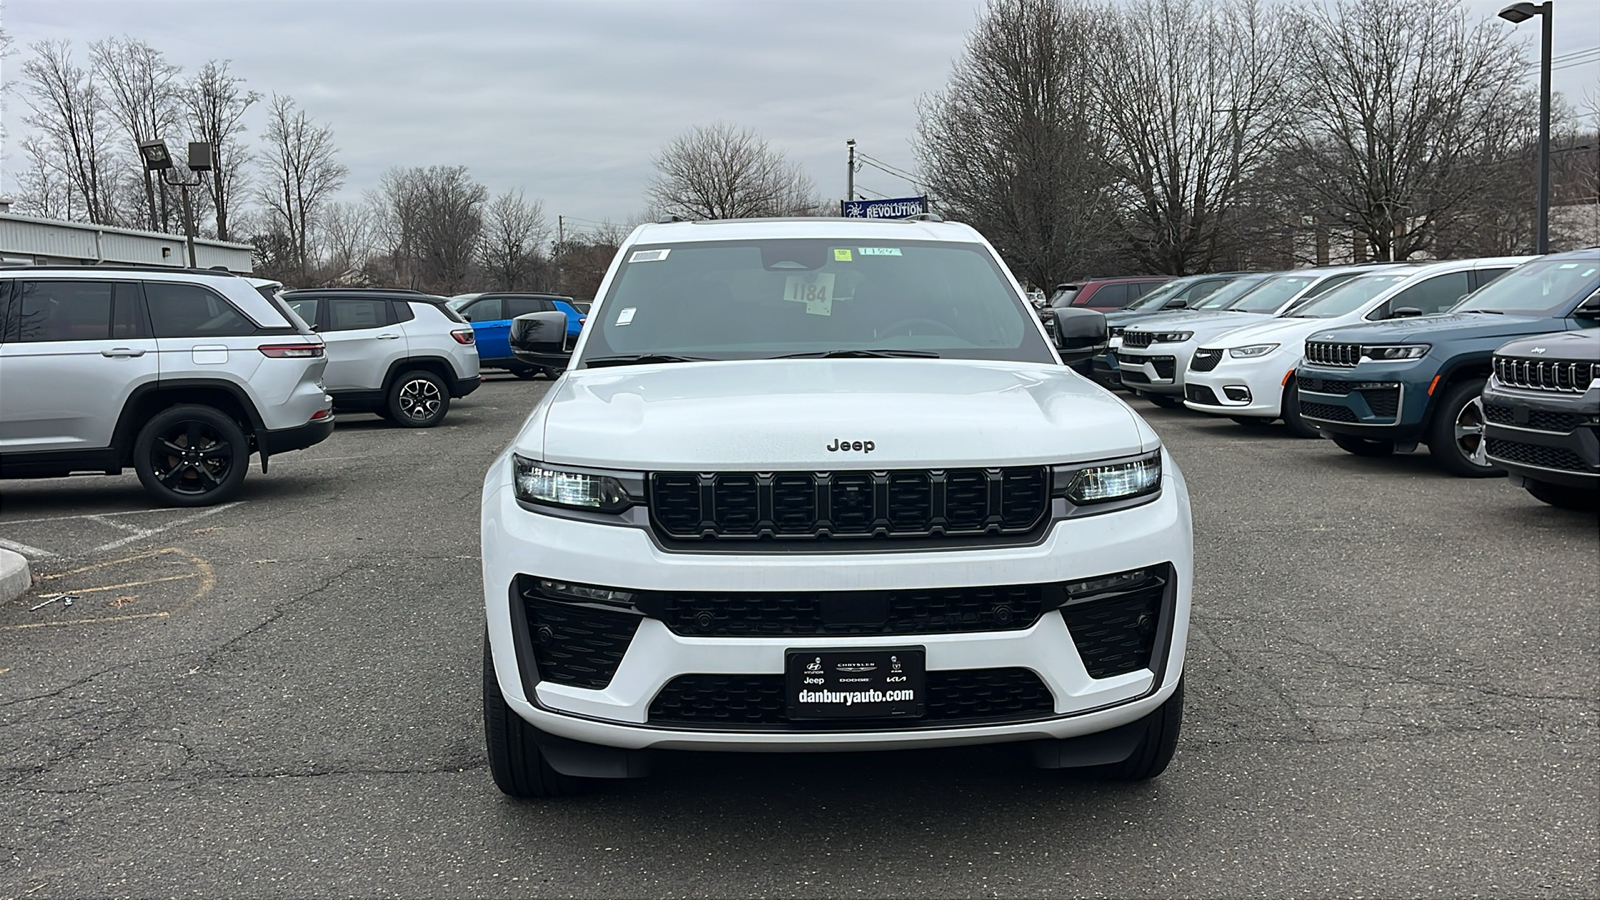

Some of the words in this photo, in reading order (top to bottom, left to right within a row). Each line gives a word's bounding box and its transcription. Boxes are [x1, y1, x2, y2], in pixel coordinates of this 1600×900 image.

[866, 204, 923, 219] REVOLUTION
[792, 282, 827, 303] 1184
[826, 438, 876, 454] Jeep
[803, 676, 825, 685] Jeep
[798, 688, 914, 706] danburyauto.com
